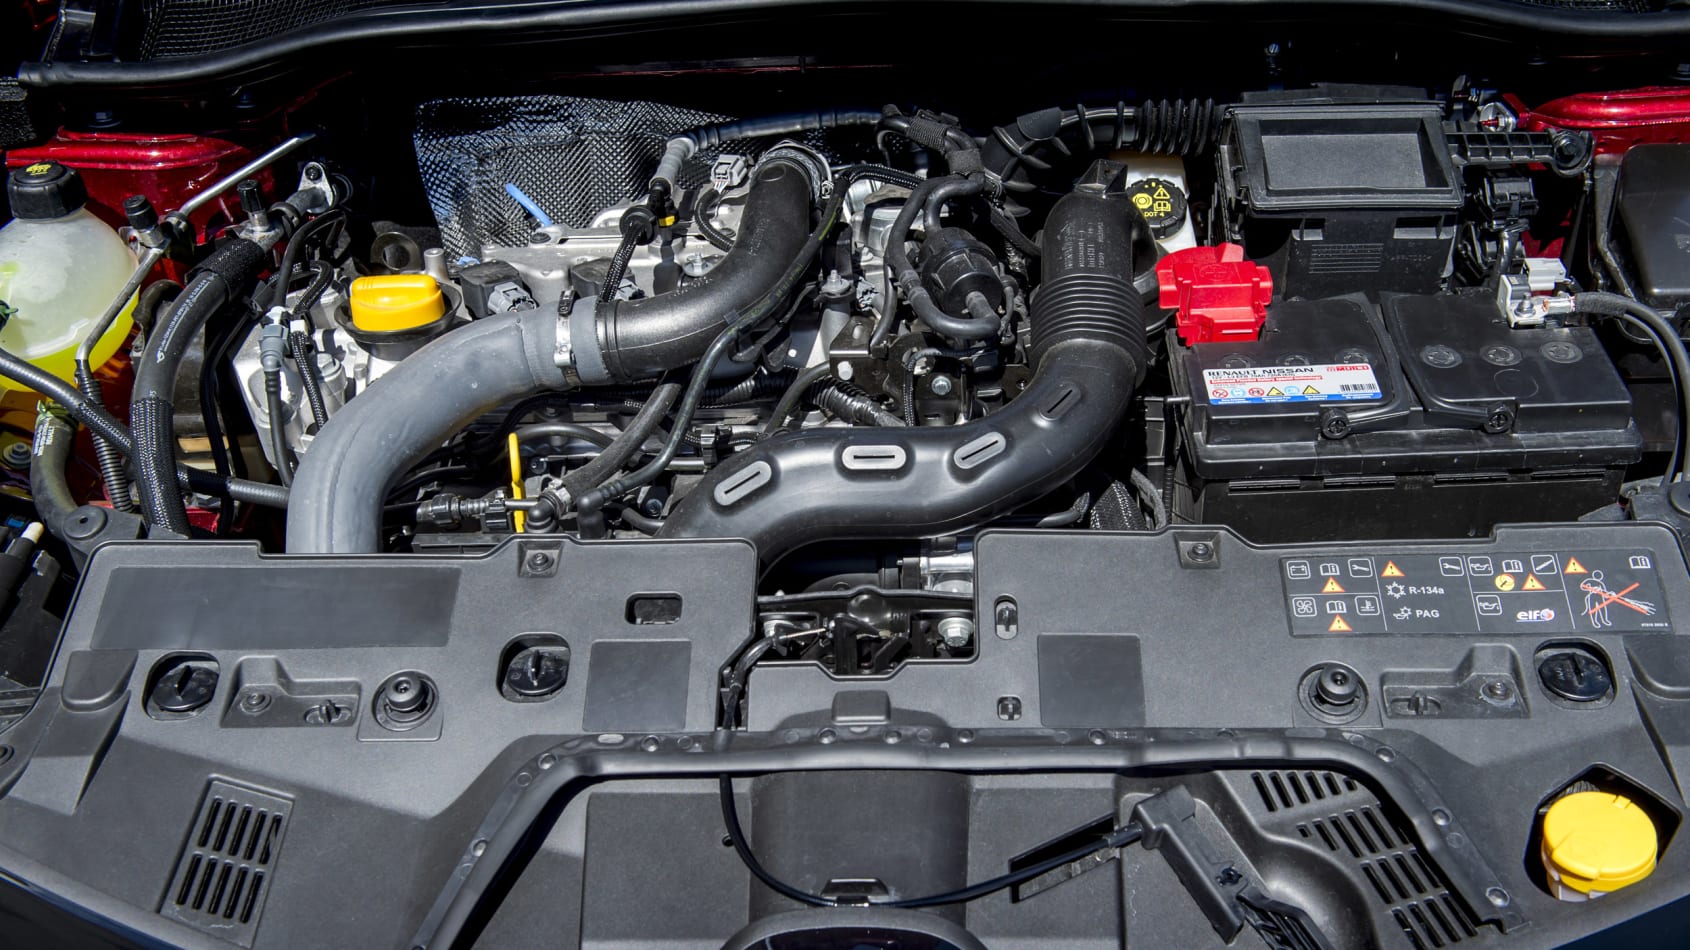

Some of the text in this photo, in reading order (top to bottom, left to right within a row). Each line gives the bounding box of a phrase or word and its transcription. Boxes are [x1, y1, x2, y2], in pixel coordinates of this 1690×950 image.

[1208, 369, 1257, 377] RENAULT
[1408, 586, 1445, 595] R-134a
[1415, 609, 1440, 618] PAG
